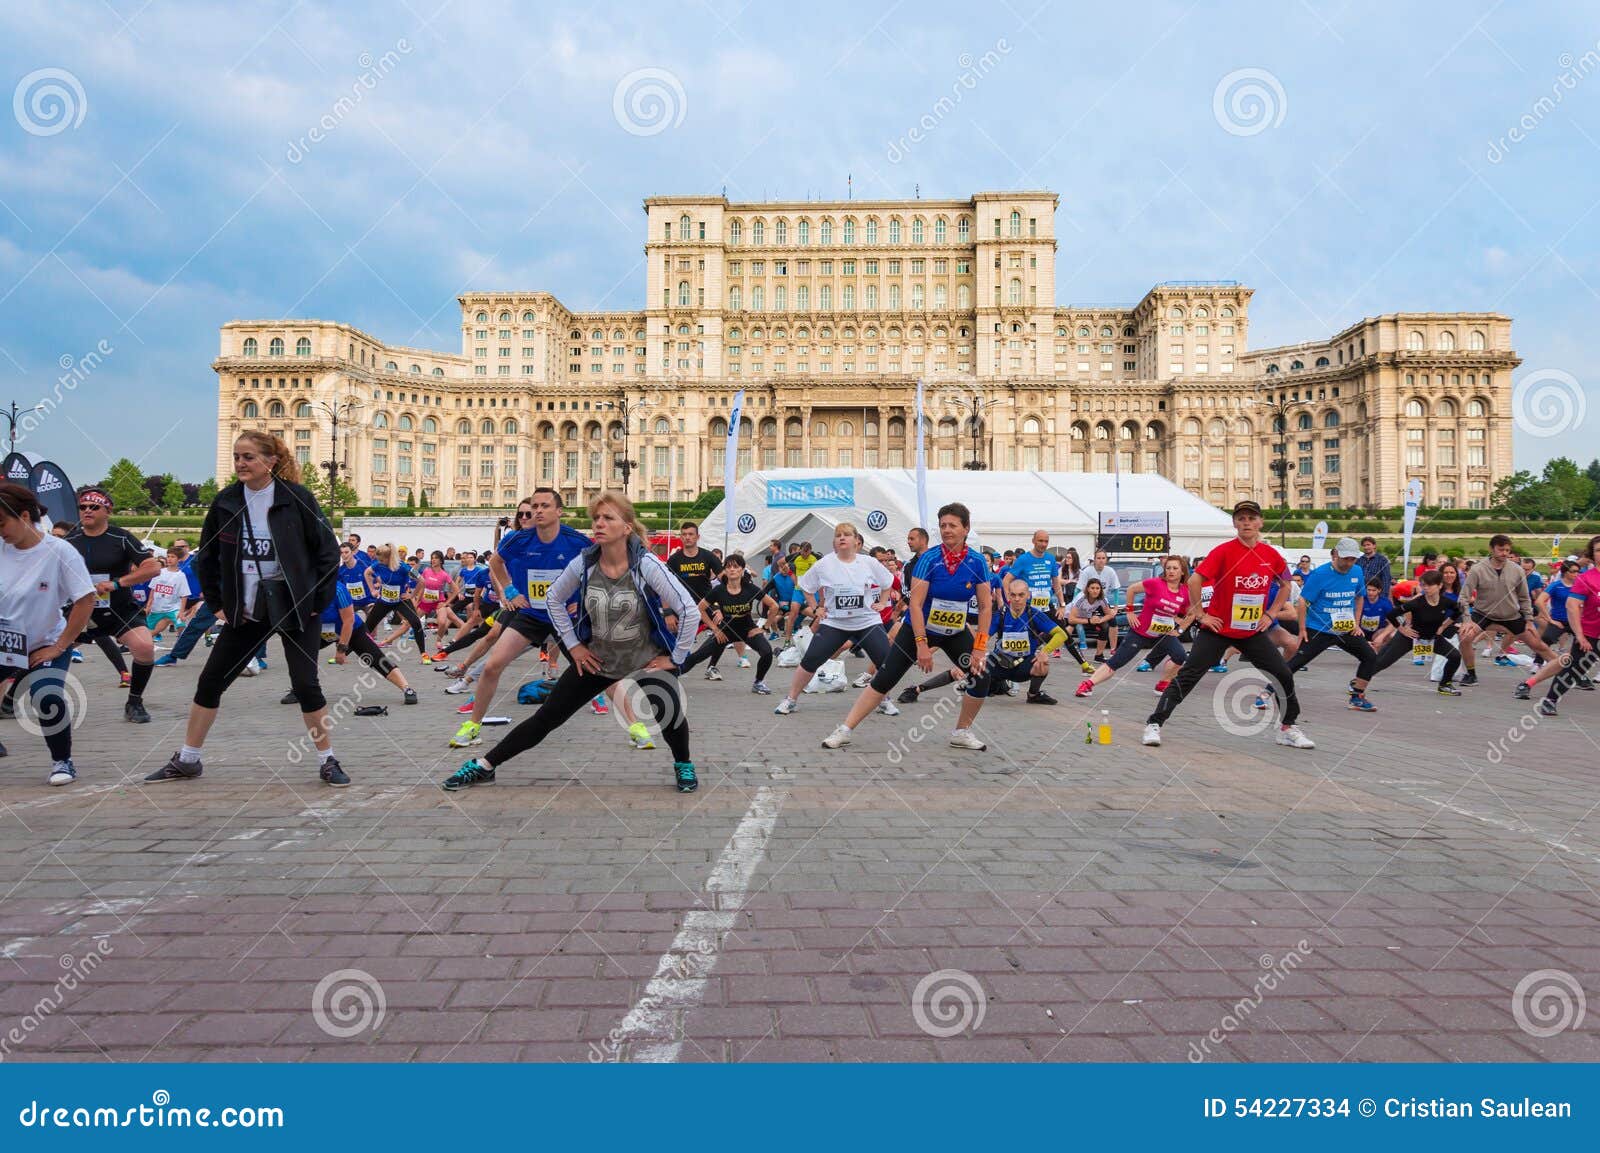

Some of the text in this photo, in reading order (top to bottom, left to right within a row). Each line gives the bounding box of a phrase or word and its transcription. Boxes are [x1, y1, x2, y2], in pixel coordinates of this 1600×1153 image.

[771, 486, 809, 500] Think
[837, 596, 860, 606] CP271
[932, 611, 964, 625] 5662
[1004, 640, 1028, 650] 3002
